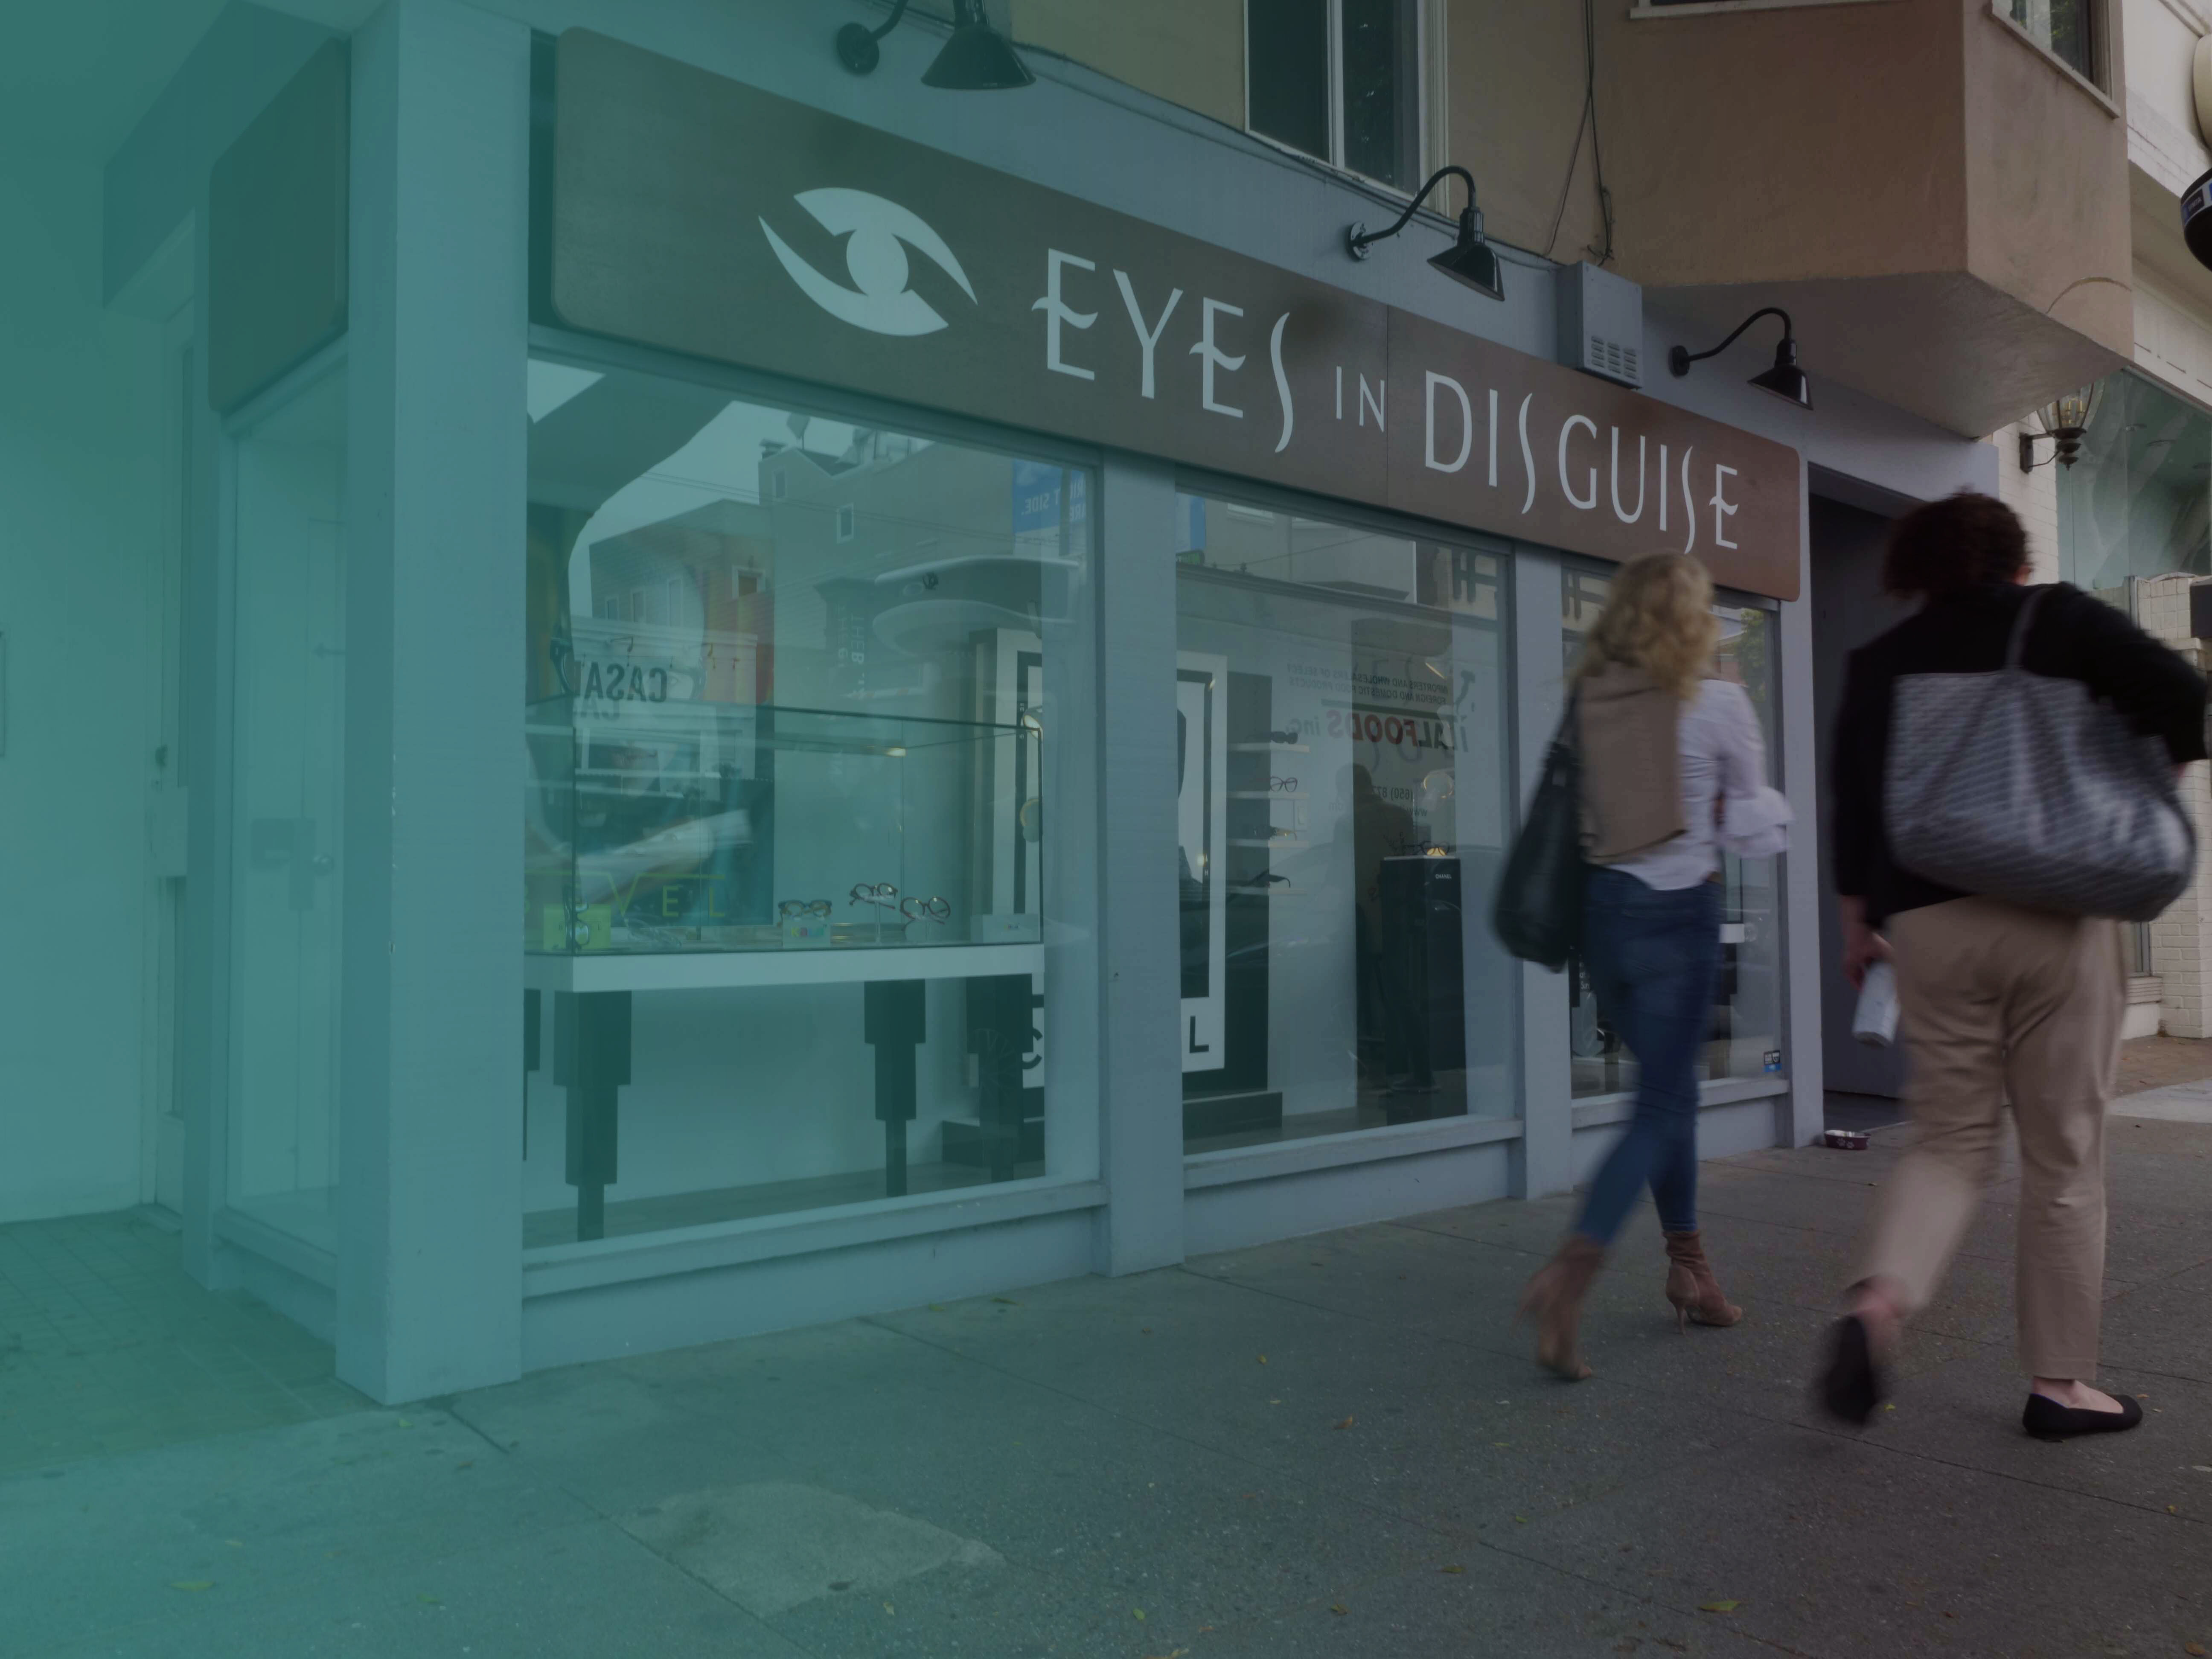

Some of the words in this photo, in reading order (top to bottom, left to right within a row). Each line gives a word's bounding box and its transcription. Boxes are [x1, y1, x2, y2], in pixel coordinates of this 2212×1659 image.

[1031, 248, 1294, 454] EYES
[1336, 365, 1385, 432] IN
[1425, 370, 1739, 554] DISGUISE
